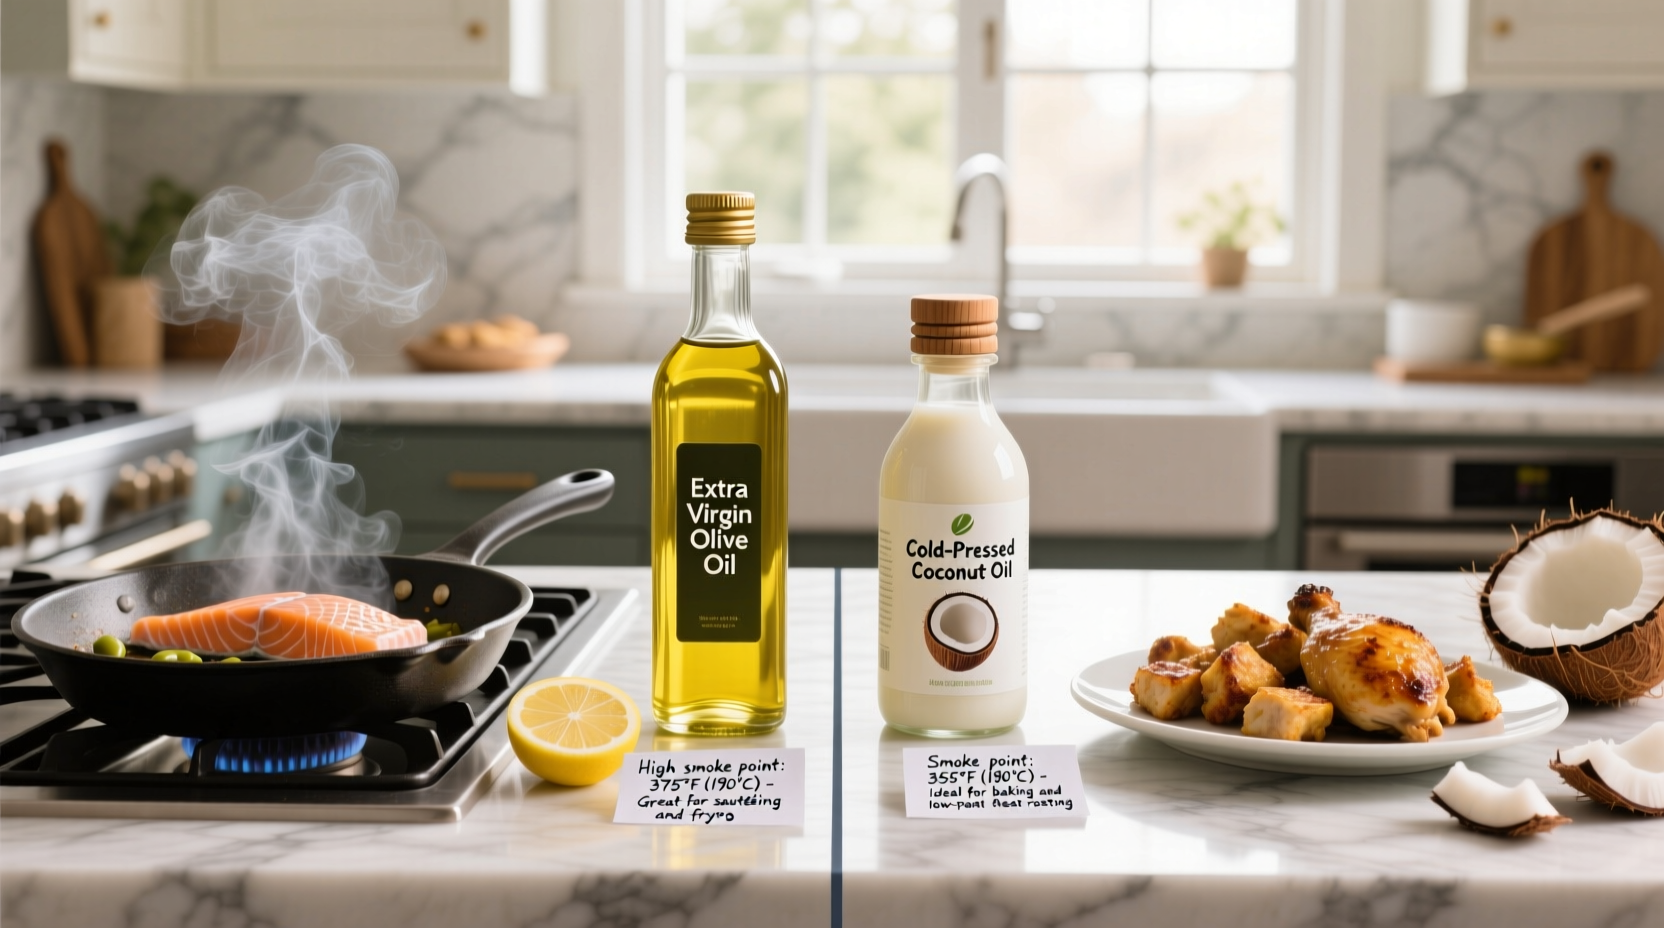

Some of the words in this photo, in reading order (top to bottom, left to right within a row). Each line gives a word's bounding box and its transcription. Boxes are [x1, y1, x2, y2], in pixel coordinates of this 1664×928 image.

[691, 477, 749, 499] Extra
[686, 503, 752, 531] Virgin
[690, 528, 749, 550] Olive
[905, 537, 1015, 559] Cold-Pressed
[703, 553, 736, 575] Oil
[911, 560, 987, 581] Coconut
[990, 559, 1012, 579] Oil
[638, 759, 676, 779] High
[684, 758, 732, 774] smoke
[737, 759, 785, 777] point:
[927, 753, 980, 769] Smoke
[989, 754, 1034, 770] point:
[637, 795, 681, 808] Great
[687, 793, 709, 807] for
[929, 786, 962, 798] Ideal
[967, 785, 987, 799] for
[992, 785, 1034, 799] baking
[1039, 784, 1062, 796] and
[655, 808, 685, 820] and
